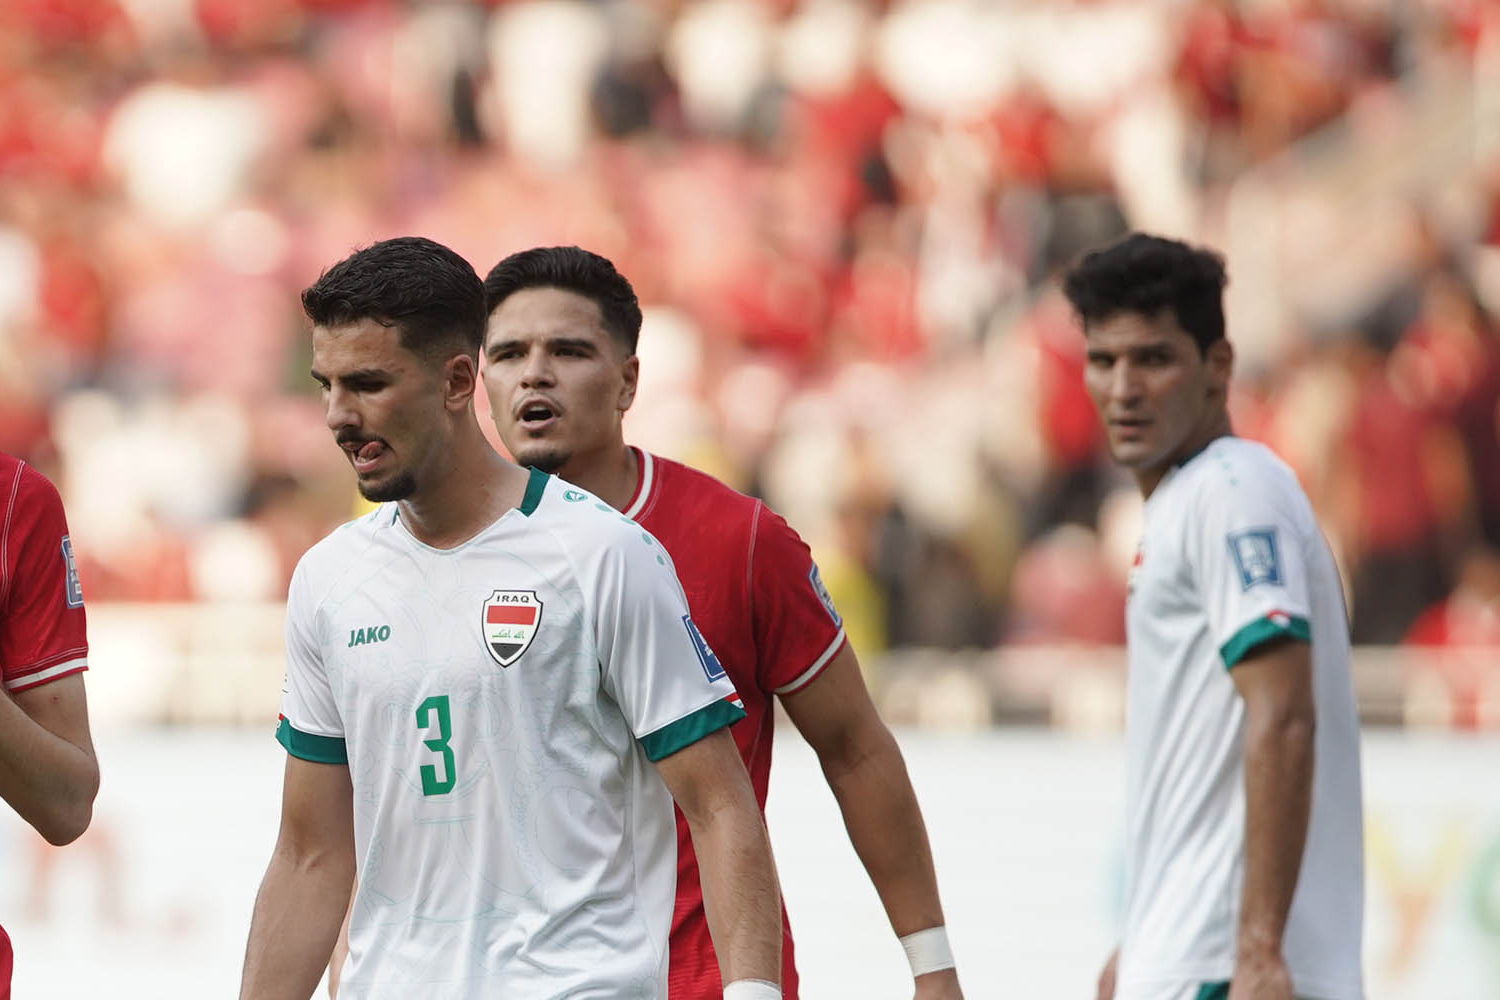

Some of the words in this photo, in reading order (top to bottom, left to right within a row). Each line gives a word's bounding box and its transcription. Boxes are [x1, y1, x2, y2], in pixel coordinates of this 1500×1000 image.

[496, 595, 530, 603] IRAQ
[348, 625, 391, 648] JAKO
[415, 695, 456, 796] 3
